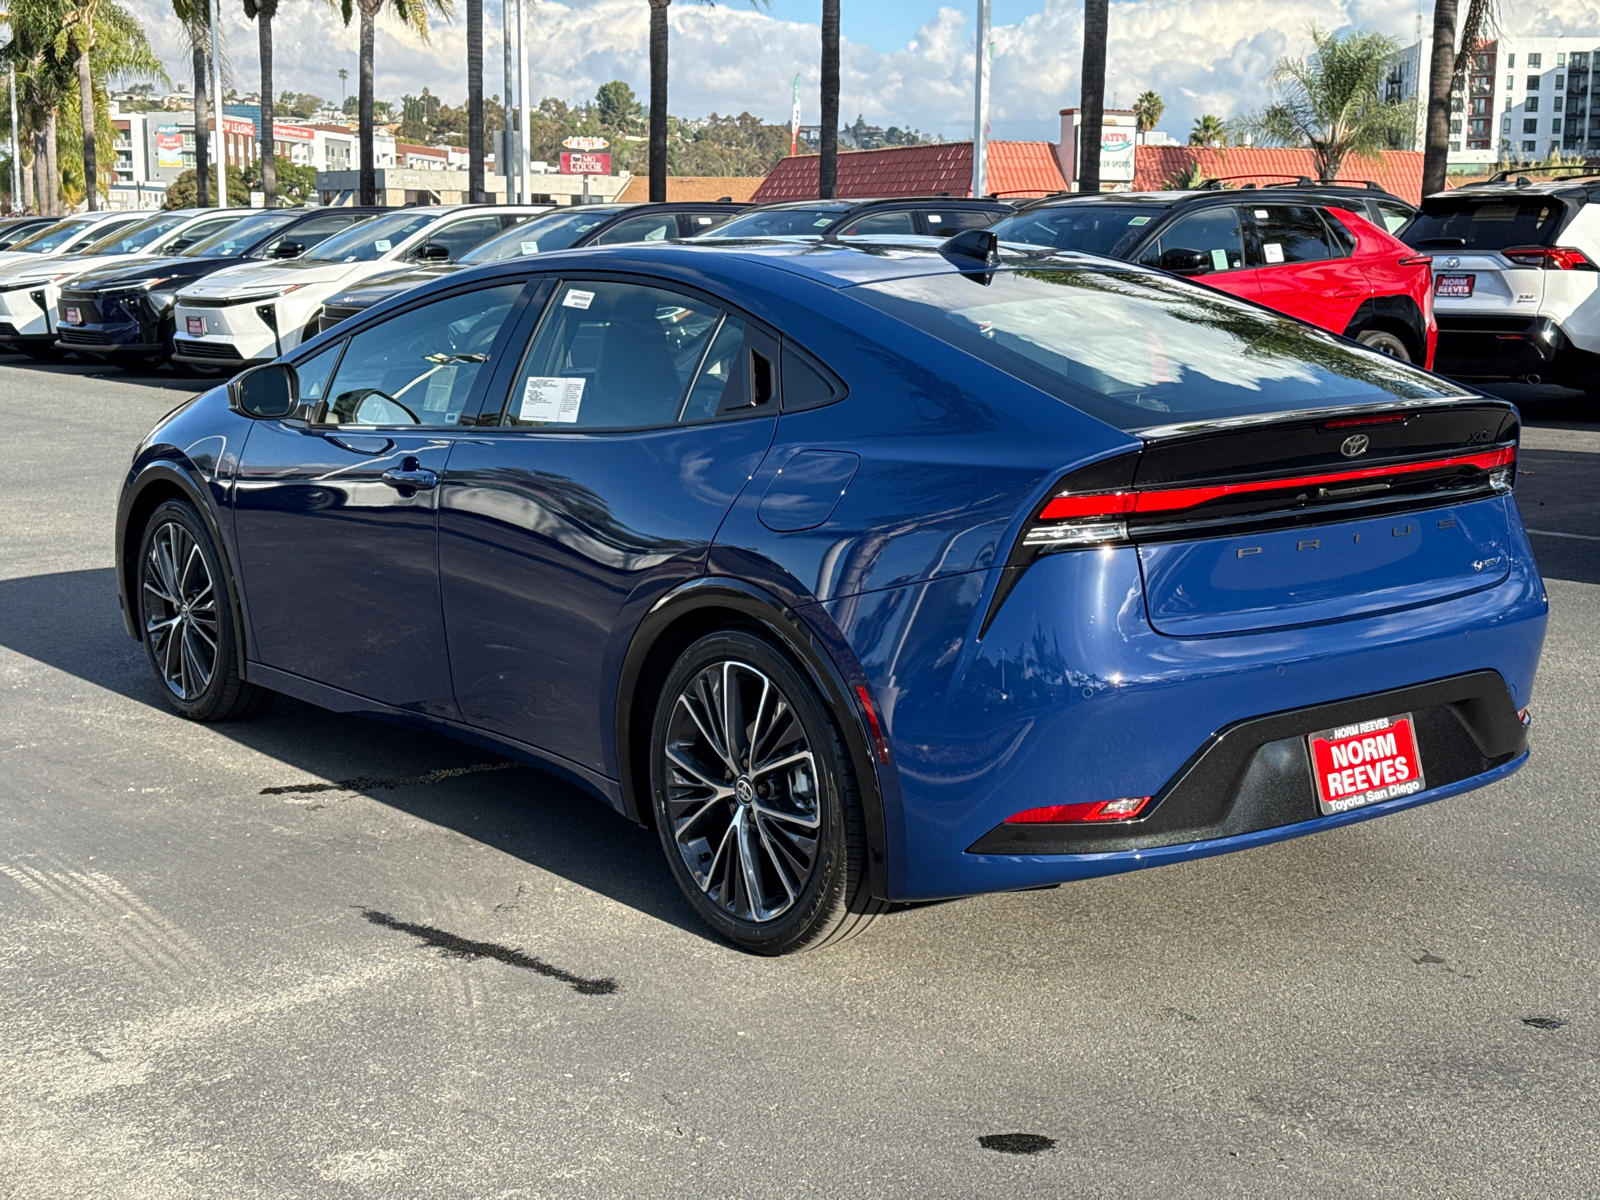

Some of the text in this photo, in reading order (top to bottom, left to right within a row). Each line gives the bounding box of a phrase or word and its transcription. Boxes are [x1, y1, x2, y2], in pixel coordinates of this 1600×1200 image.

[232, 122, 253, 135] LEASING
[1100, 160, 1131, 168] EER-SPORTS
[1442, 278, 1467, 286] NORM
[1236, 518, 1456, 559] PRIUS
[1334, 718, 1389, 739] NORM REEVES
[1330, 732, 1398, 769] NORM
[1327, 756, 1409, 797] REEVES
[1329, 781, 1420, 811] Toyota San Diego
